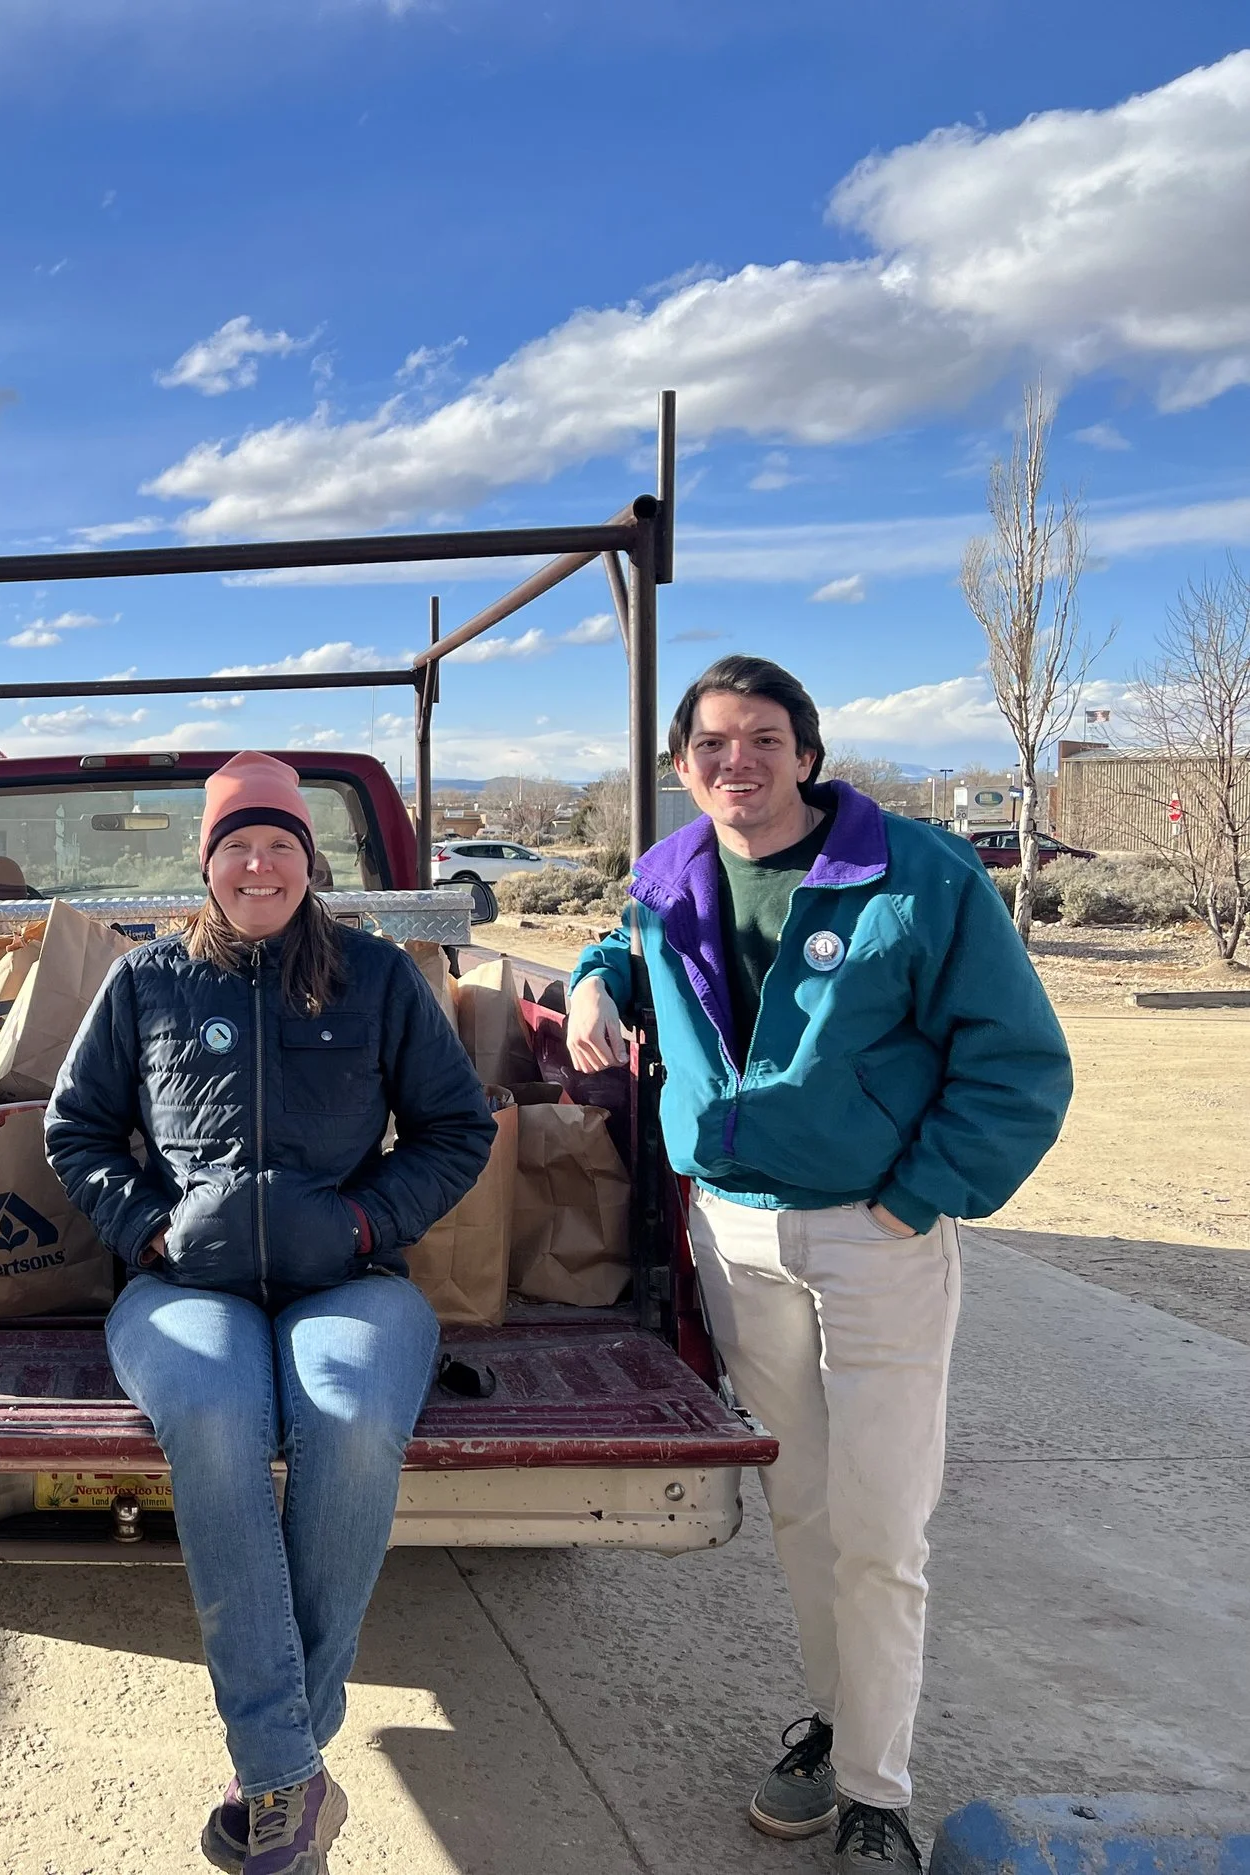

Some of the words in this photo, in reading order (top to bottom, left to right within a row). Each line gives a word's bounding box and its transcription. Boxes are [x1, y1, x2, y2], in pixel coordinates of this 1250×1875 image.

[76, 1485, 103, 1495] New
[104, 1484, 152, 1496] Mexico
[154, 1485, 172, 1496] US
[92, 1496, 109, 1506] Land
